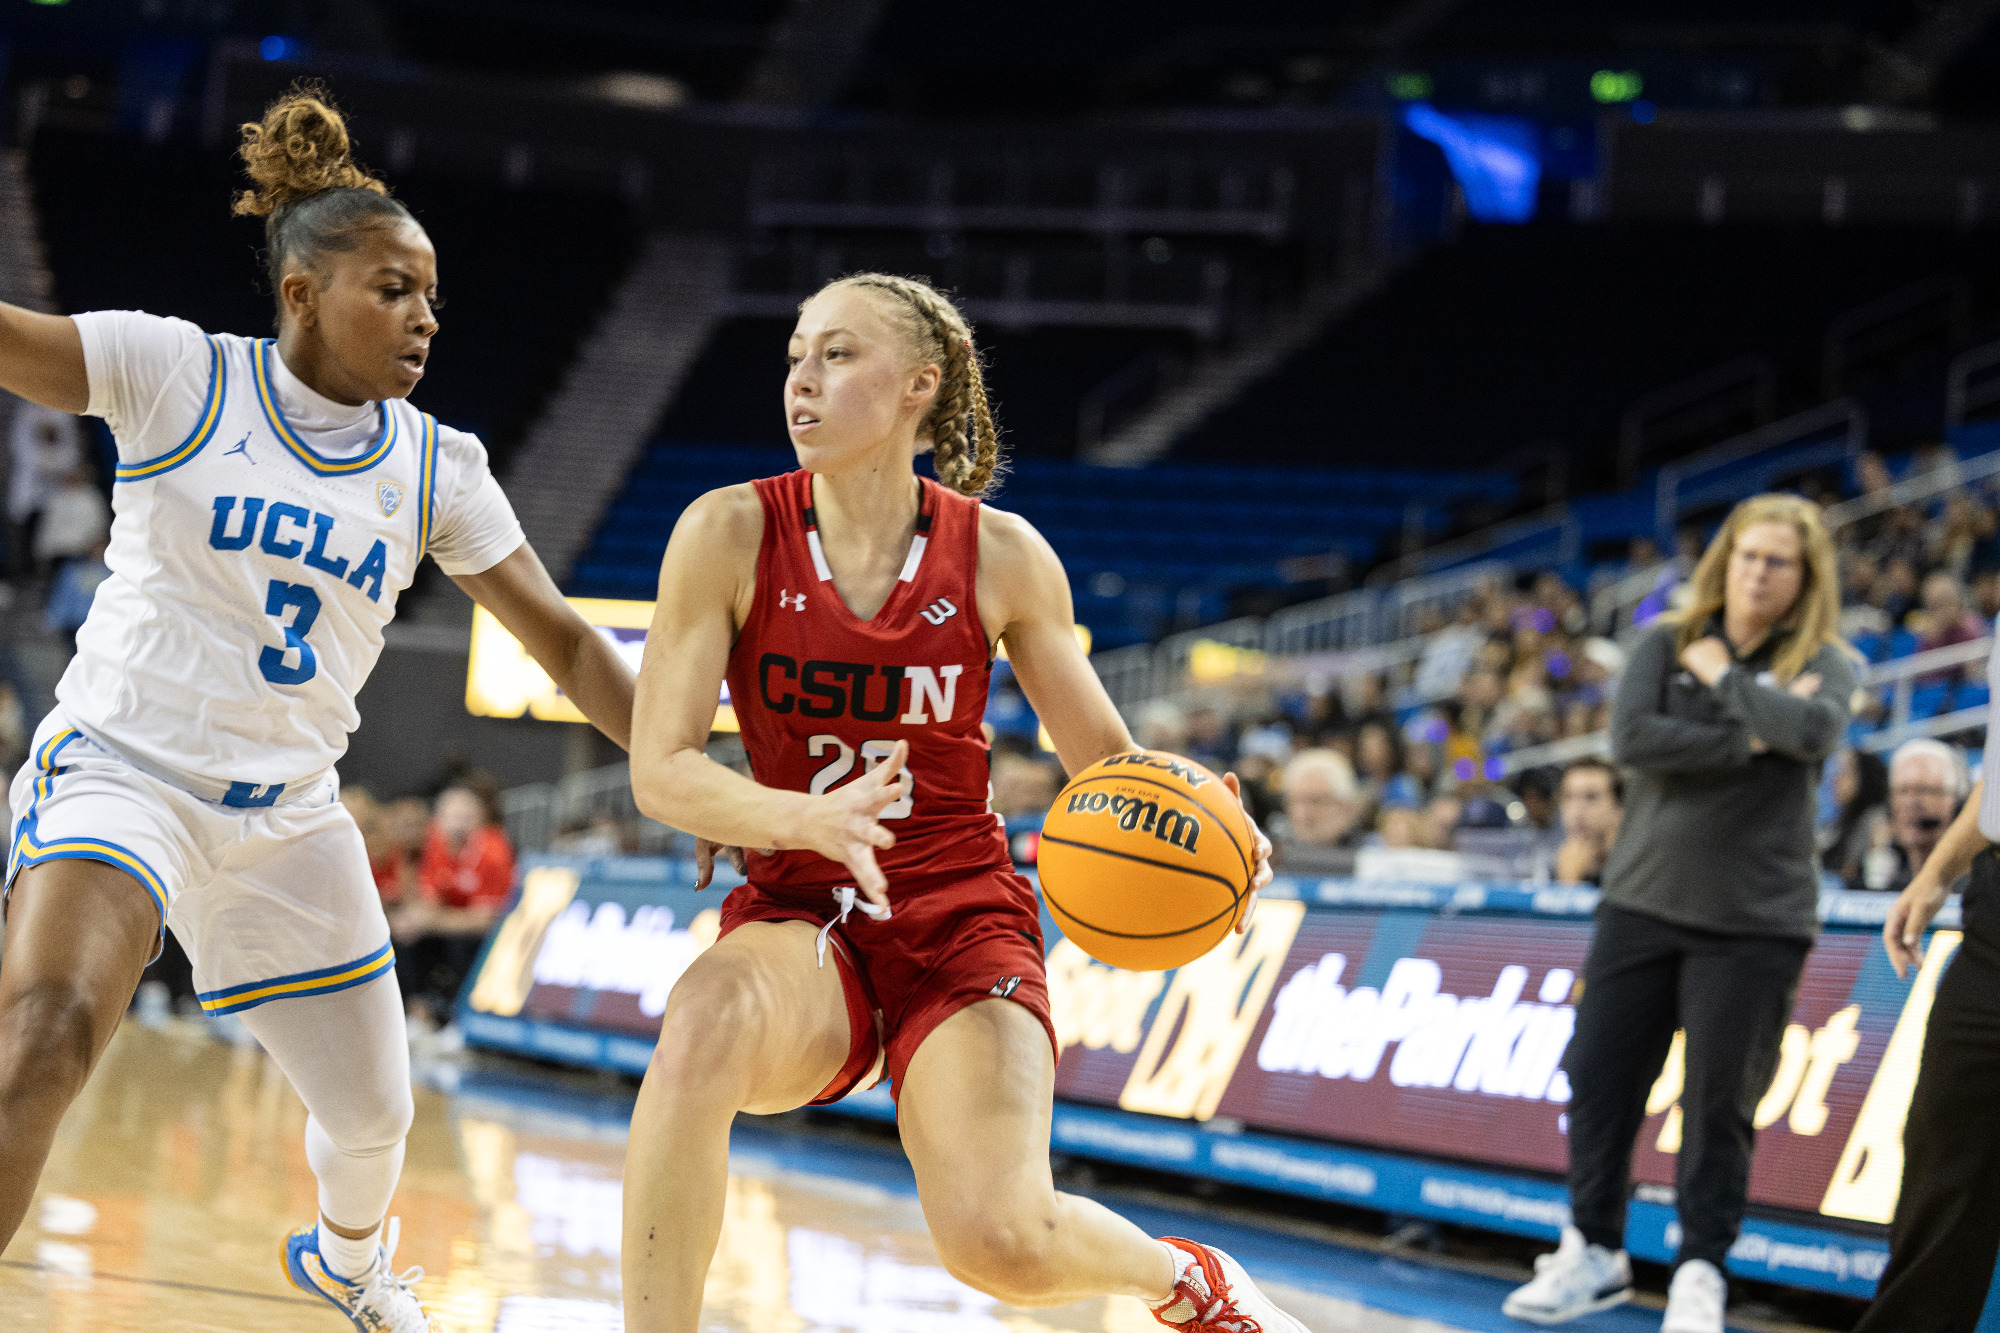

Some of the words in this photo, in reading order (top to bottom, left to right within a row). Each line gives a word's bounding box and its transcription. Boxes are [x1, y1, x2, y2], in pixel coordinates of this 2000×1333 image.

[209, 496, 388, 603] UCLA
[258, 579, 322, 685] 3
[758, 652, 963, 725] CSUN
[1067, 792, 1200, 855] Wilson
